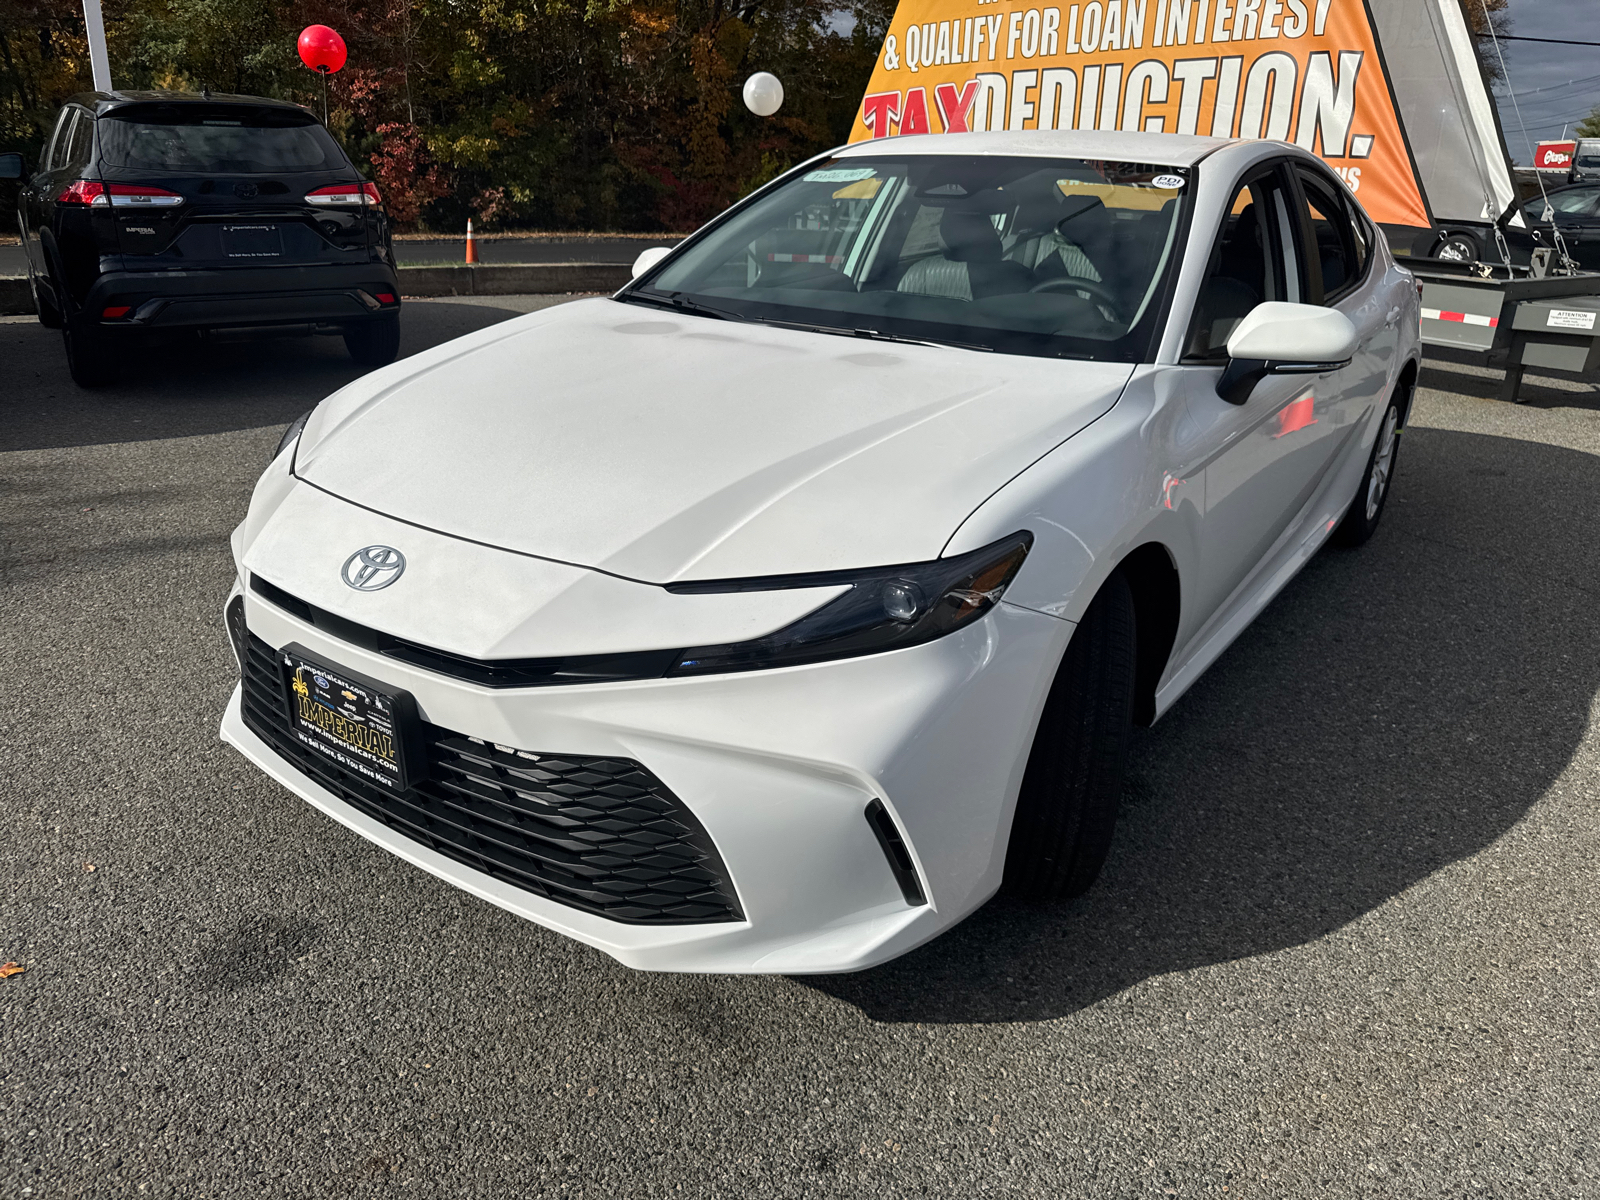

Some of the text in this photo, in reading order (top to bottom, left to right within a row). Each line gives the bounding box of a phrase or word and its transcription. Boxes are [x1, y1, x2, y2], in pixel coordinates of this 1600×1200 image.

[883, 0, 1332, 73] & QUALIFY FOR LOAN INTEREST
[863, 50, 1375, 159] TAX DEDUCTION.
[1158, 176, 1182, 184] PDI
[298, 694, 396, 760] IMPERIAL
[300, 718, 398, 773] www.imperialcars.com
[298, 732, 392, 787] We Sell More, So You Save More
